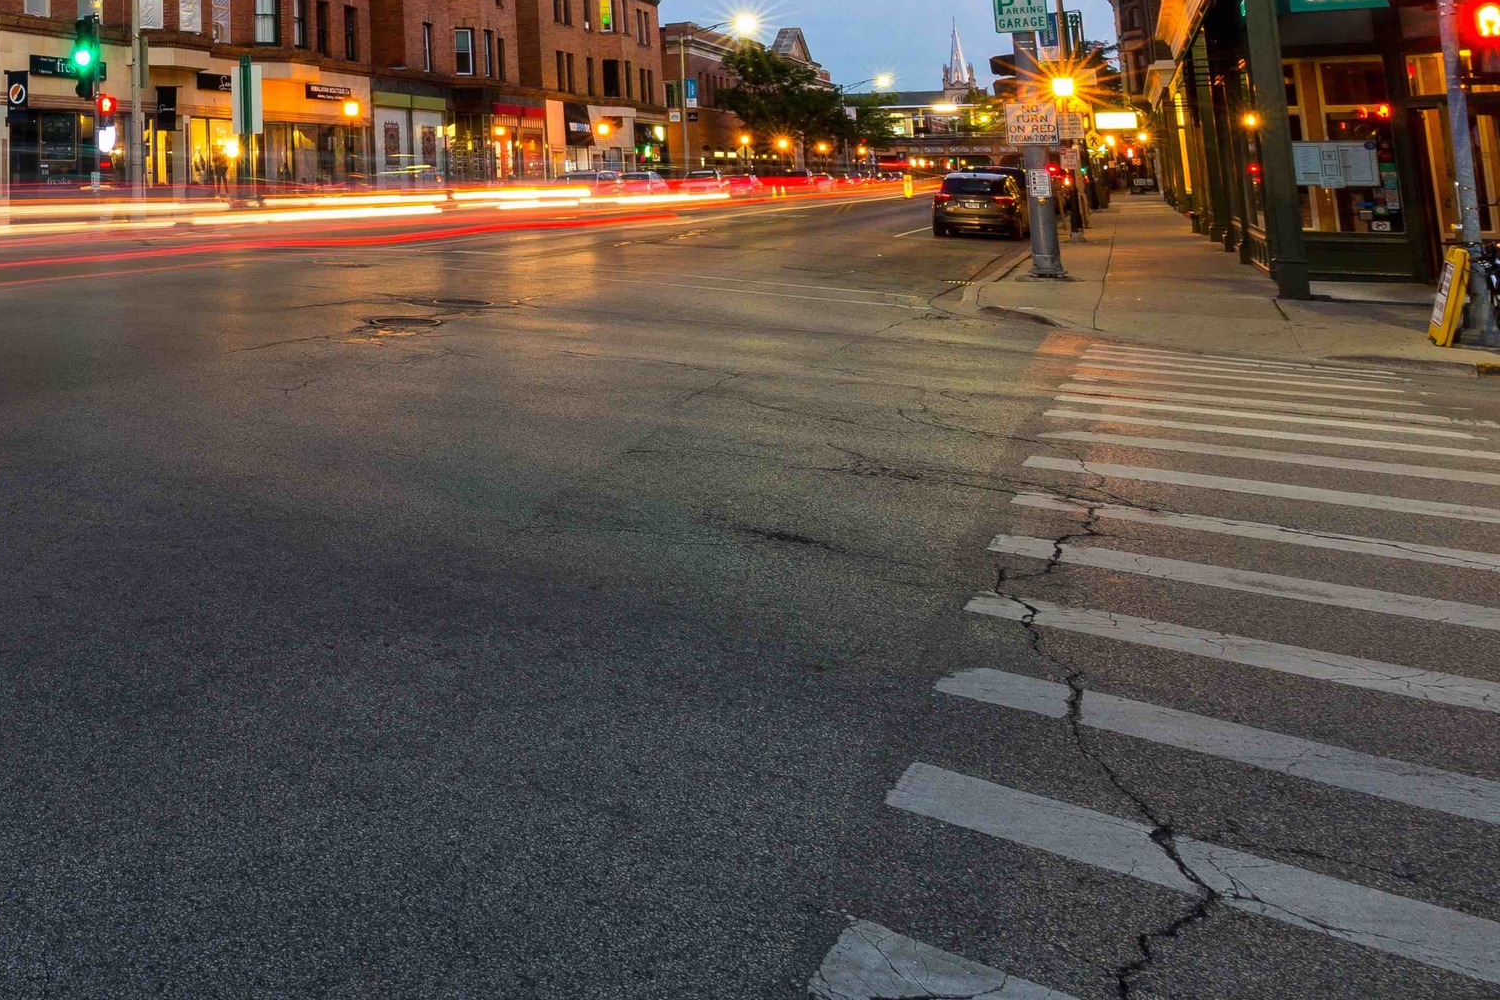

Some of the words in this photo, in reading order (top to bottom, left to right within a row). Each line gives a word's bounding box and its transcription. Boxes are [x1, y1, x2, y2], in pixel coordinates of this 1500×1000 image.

[998, 16, 1045, 29] GARAGE
[1021, 105, 1039, 113] NO
[1016, 114, 1048, 123] TURN
[1009, 124, 1025, 134] ON
[1031, 124, 1056, 133] RED
